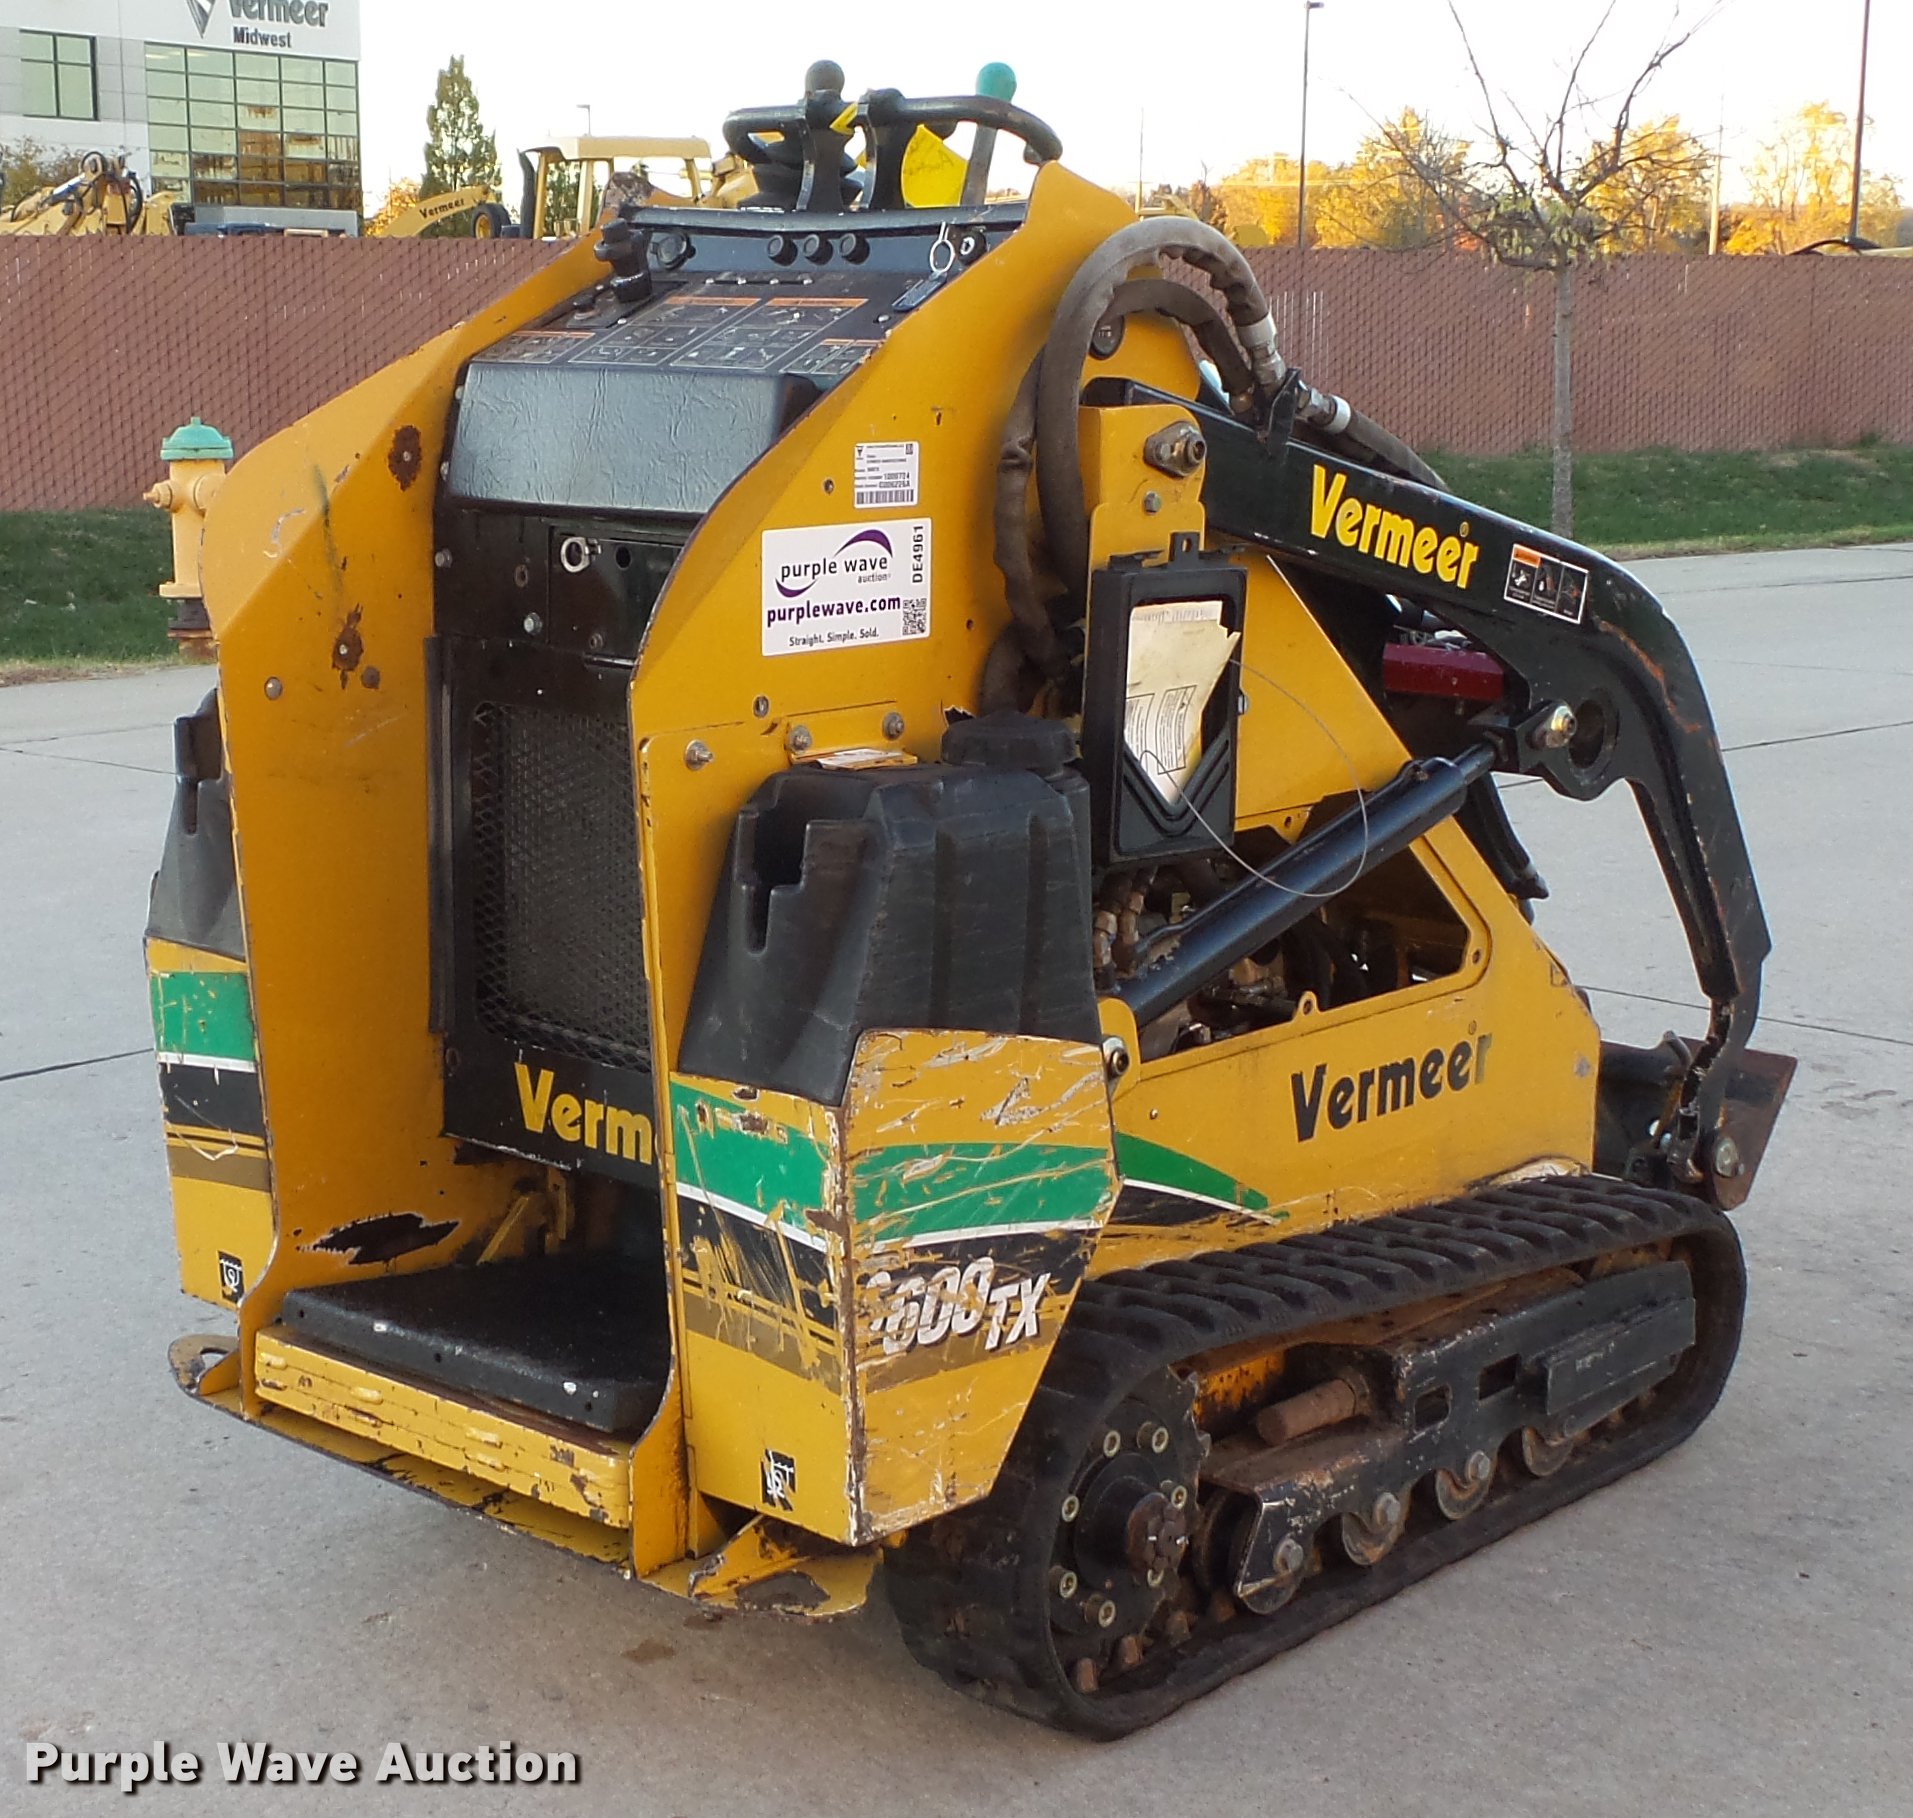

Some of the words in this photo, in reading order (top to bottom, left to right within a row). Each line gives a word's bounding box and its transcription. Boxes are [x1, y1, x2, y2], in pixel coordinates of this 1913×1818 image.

[233, 26, 292, 48] Midwest
[419, 199, 465, 219] Vermeer
[1310, 464, 1479, 589] Vermeer
[912, 525, 923, 583] DE4961
[781, 558, 837, 583] purple
[844, 556, 888, 573] wave
[857, 573, 887, 584] auction
[767, 597, 900, 628] purplewave.com
[789, 634, 824, 647] Straight.
[827, 630, 857, 643] Simple.
[860, 628, 879, 638] Sold.
[1291, 1033, 1492, 1143] Vermeer
[514, 1062, 656, 1166] Verm
